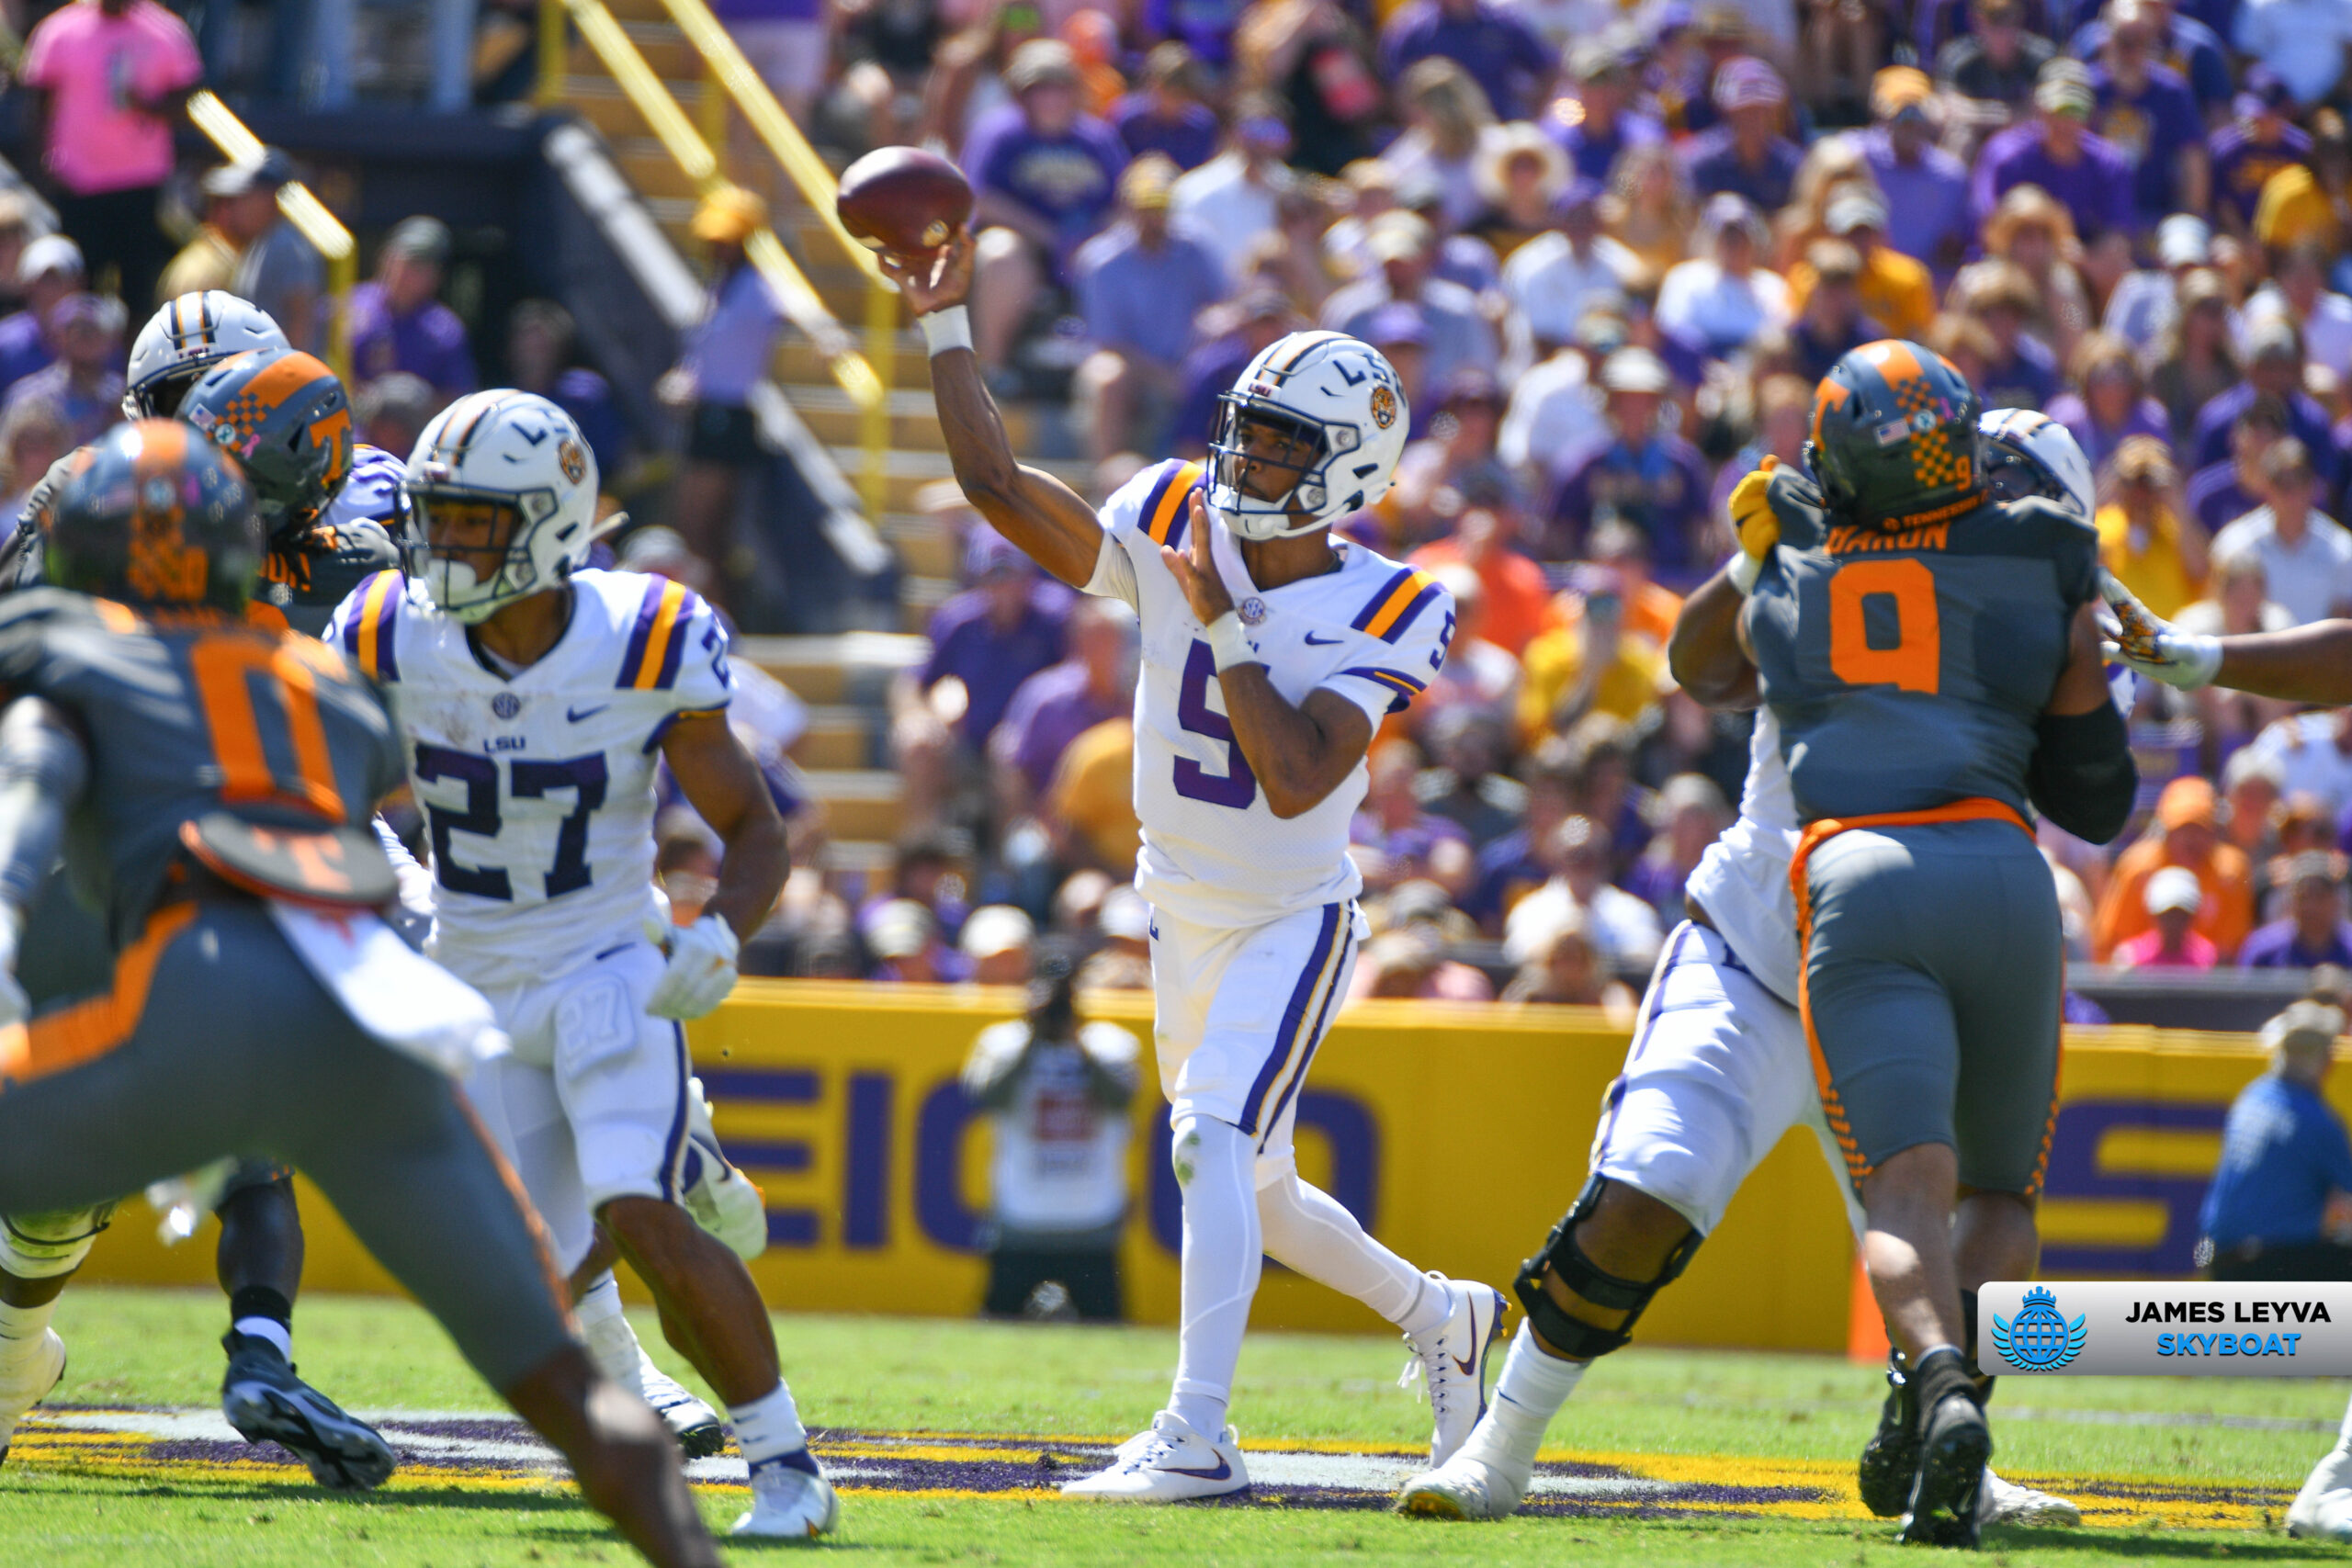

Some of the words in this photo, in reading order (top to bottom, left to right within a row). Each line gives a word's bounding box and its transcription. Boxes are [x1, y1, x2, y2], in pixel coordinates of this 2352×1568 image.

[1955, 456, 1972, 491] 9
[1829, 557, 1940, 695] 9
[483, 736, 526, 754] LSU
[1173, 637, 1271, 810] 5
[416, 742, 610, 902] 27
[695, 1066, 1382, 1272] EICO
